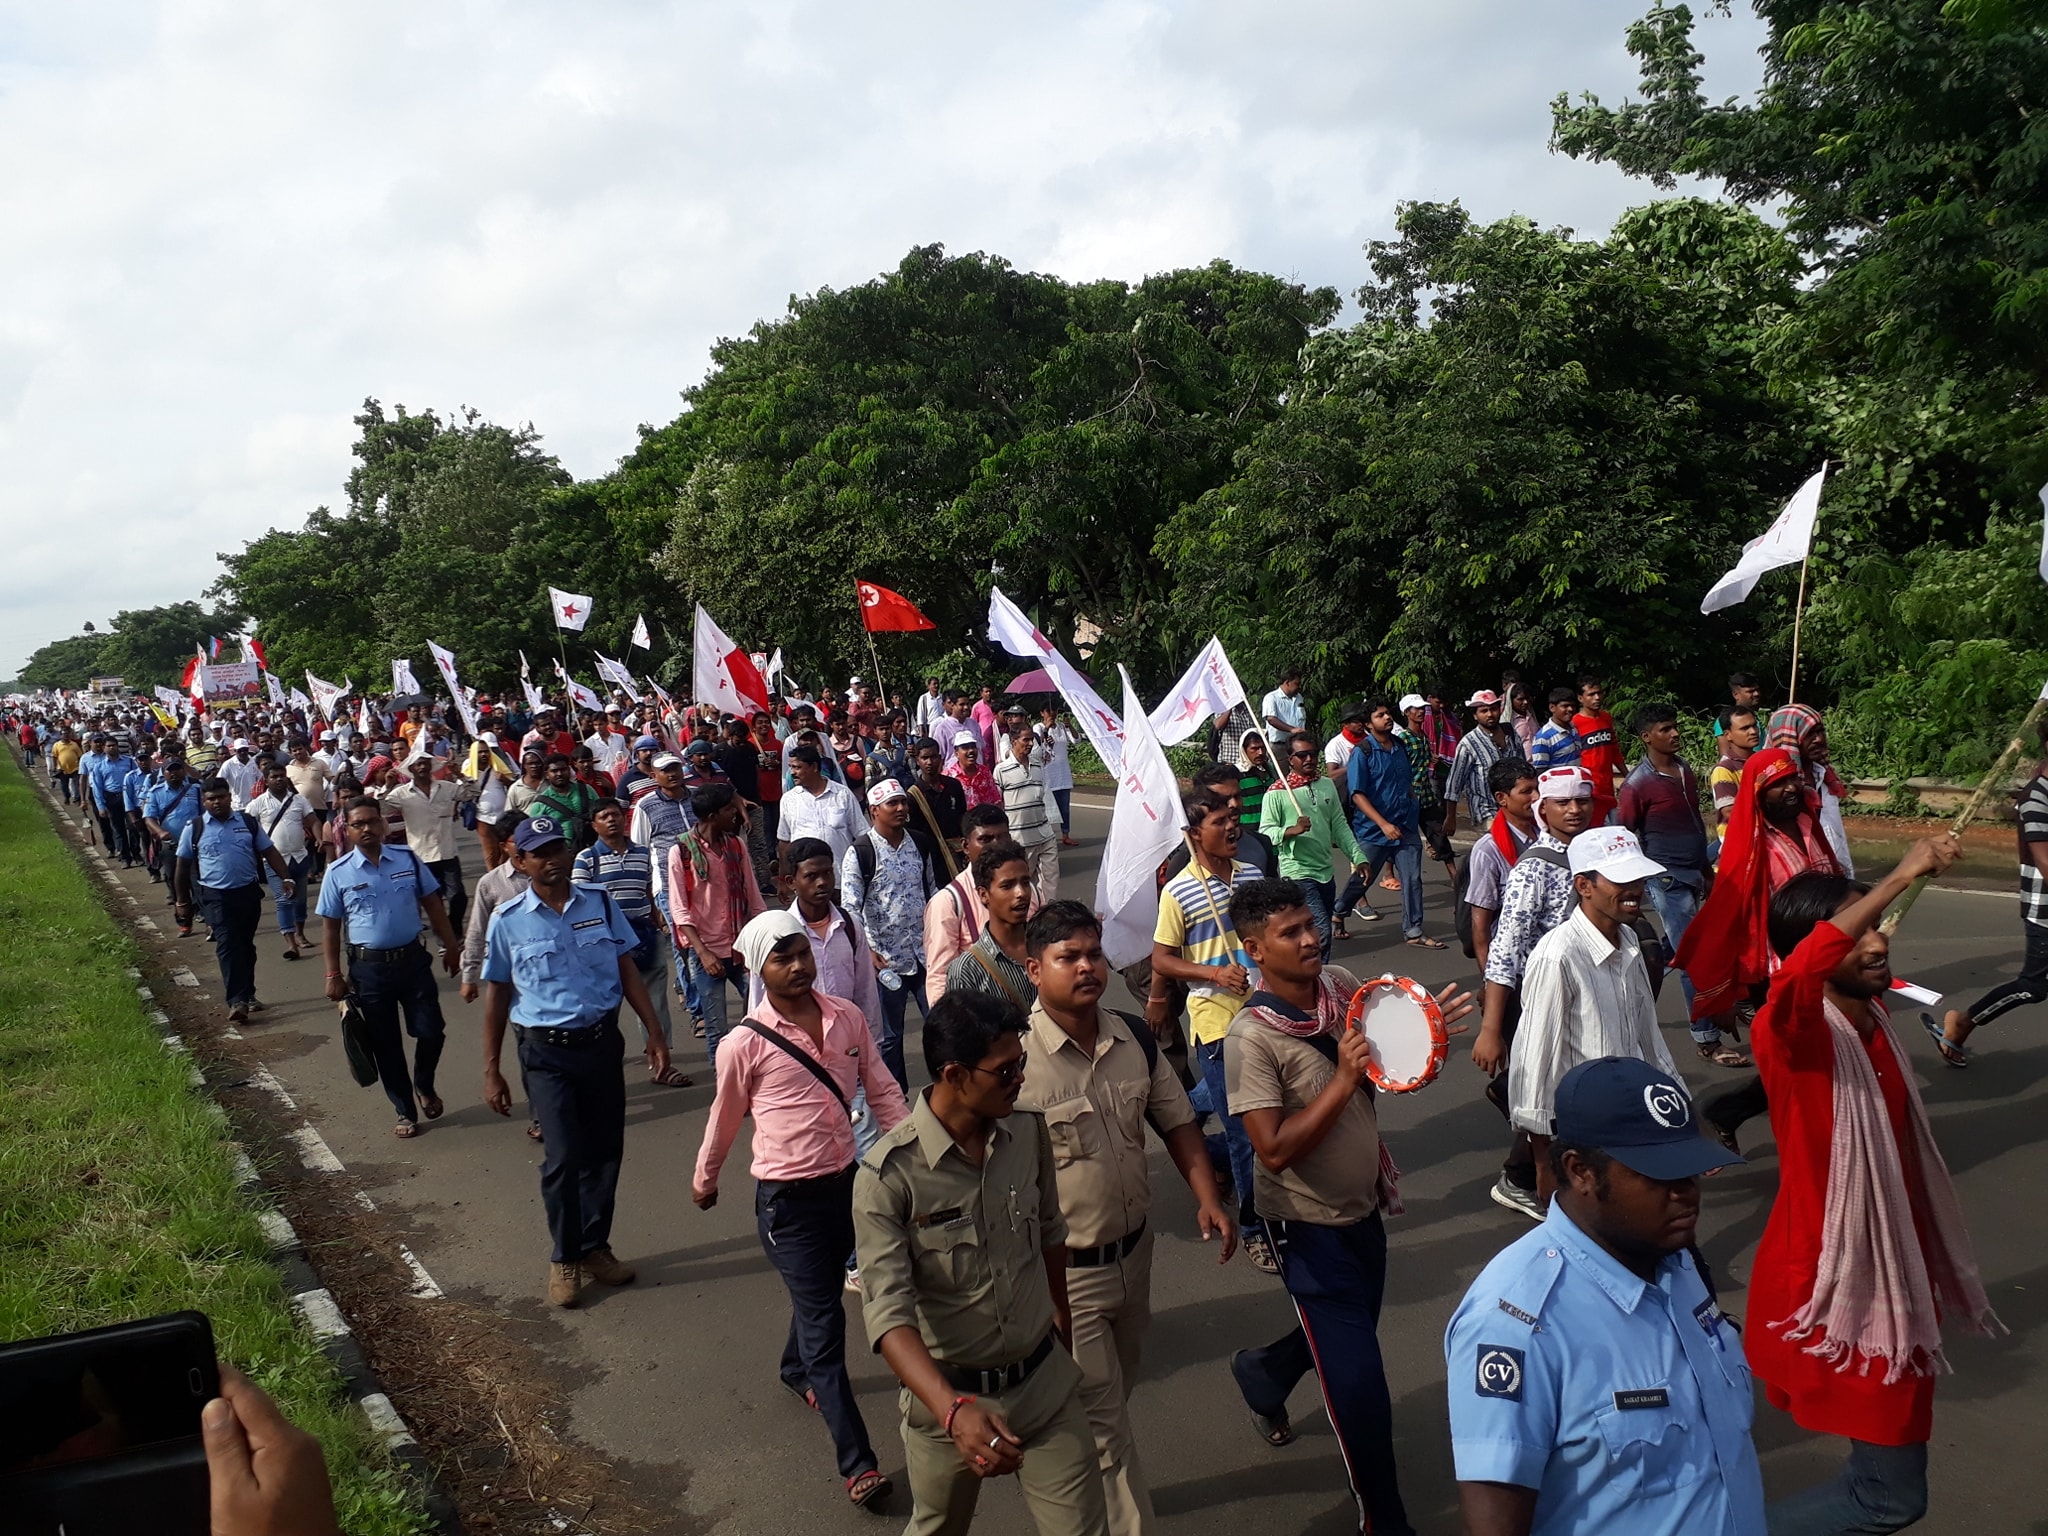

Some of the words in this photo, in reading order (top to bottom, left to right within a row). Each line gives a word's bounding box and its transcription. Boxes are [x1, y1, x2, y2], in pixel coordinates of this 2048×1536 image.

[1587, 731, 1612, 745] adida
[1653, 1093, 1681, 1114] CV
[1484, 1362, 1513, 1382] CV
